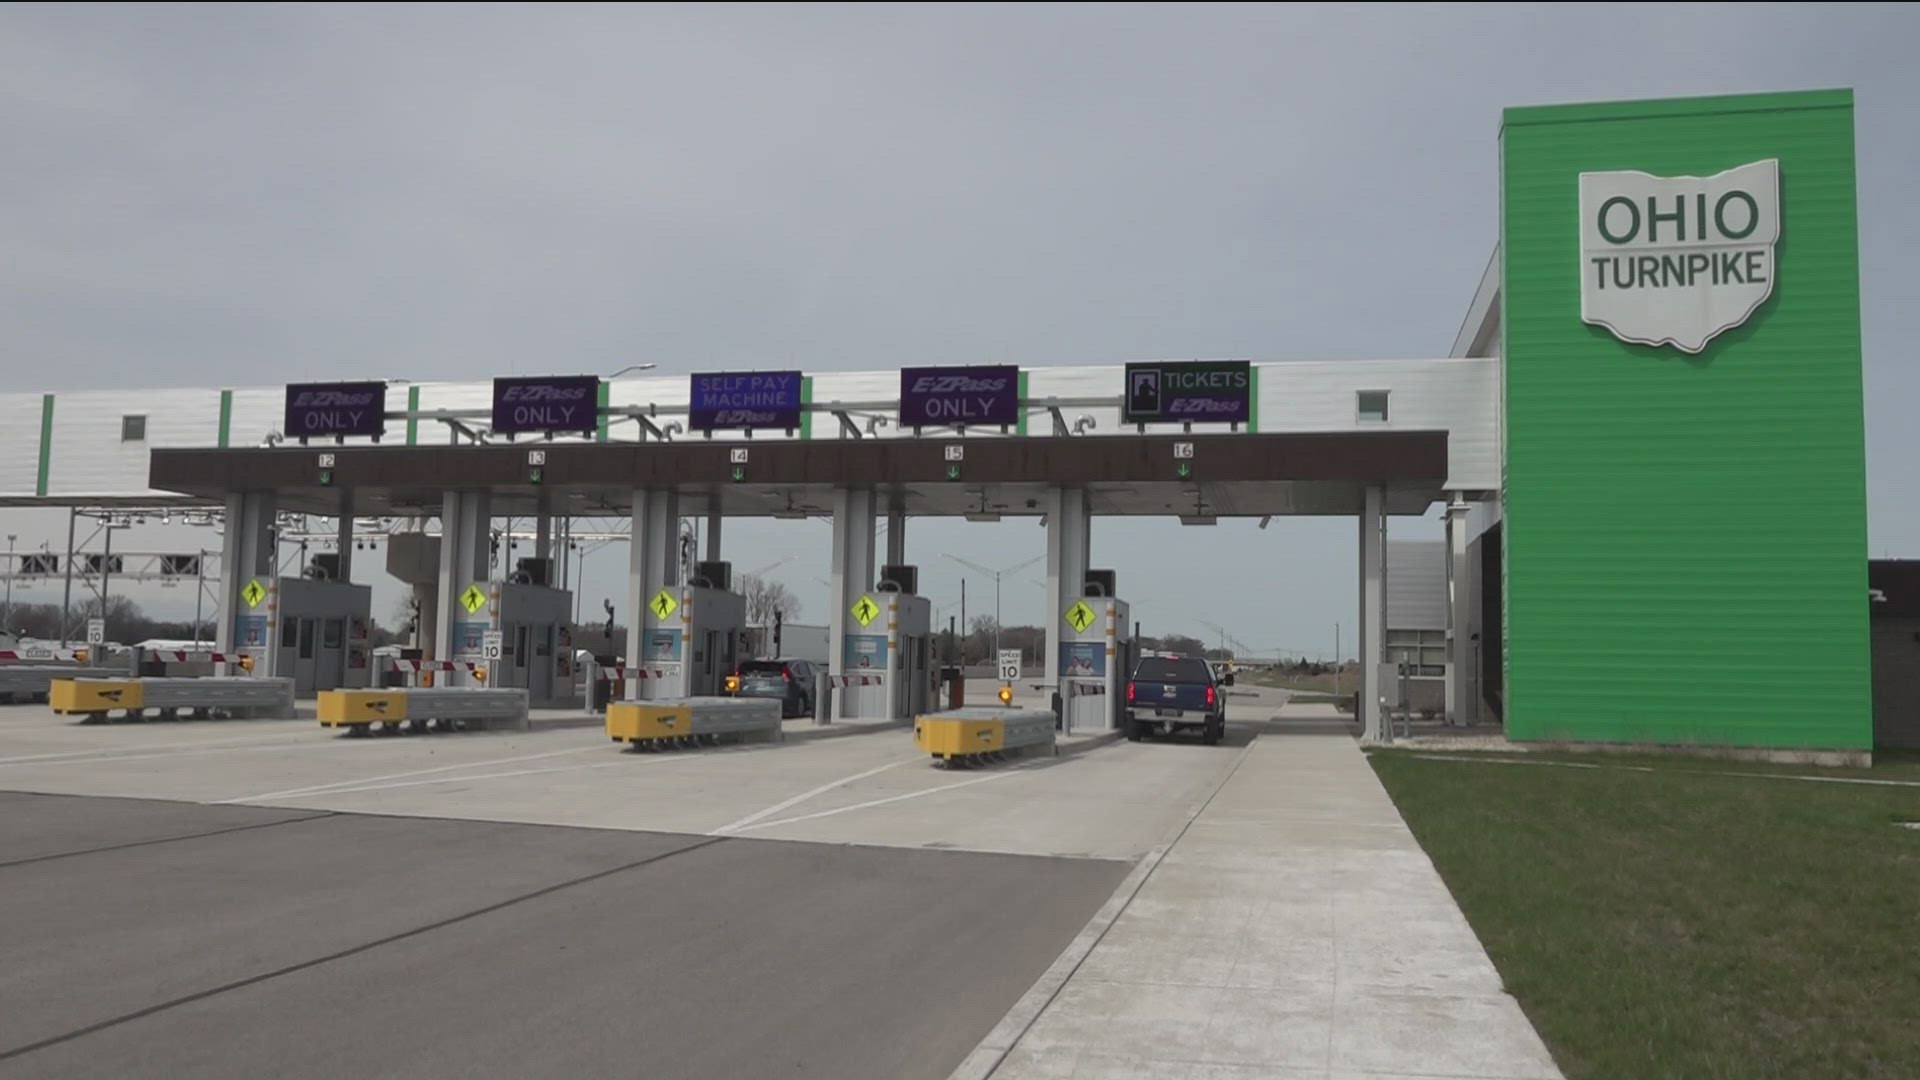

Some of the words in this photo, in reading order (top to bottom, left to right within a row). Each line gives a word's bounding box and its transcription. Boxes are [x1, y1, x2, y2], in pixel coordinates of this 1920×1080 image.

[1597, 190, 1759, 244] OHIO
[1591, 251, 1767, 290] TURNPIKE
[701, 377, 745, 392] SELF
[752, 376, 790, 390] PAY
[1165, 372, 1247, 388] TICKETS
[703, 392, 787, 407] MACHINE
[514, 406, 575, 424] ONLY
[925, 398, 995, 417] ONLY
[305, 410, 364, 429] ONLY
[732, 450, 746, 461] 14
[946, 447, 962, 459] 15
[1175, 445, 1193, 457] 16
[320, 455, 333, 467] 12
[90, 632, 101, 642] 10
[486, 646, 498, 657] 10
[1002, 666, 1017, 677] 10
